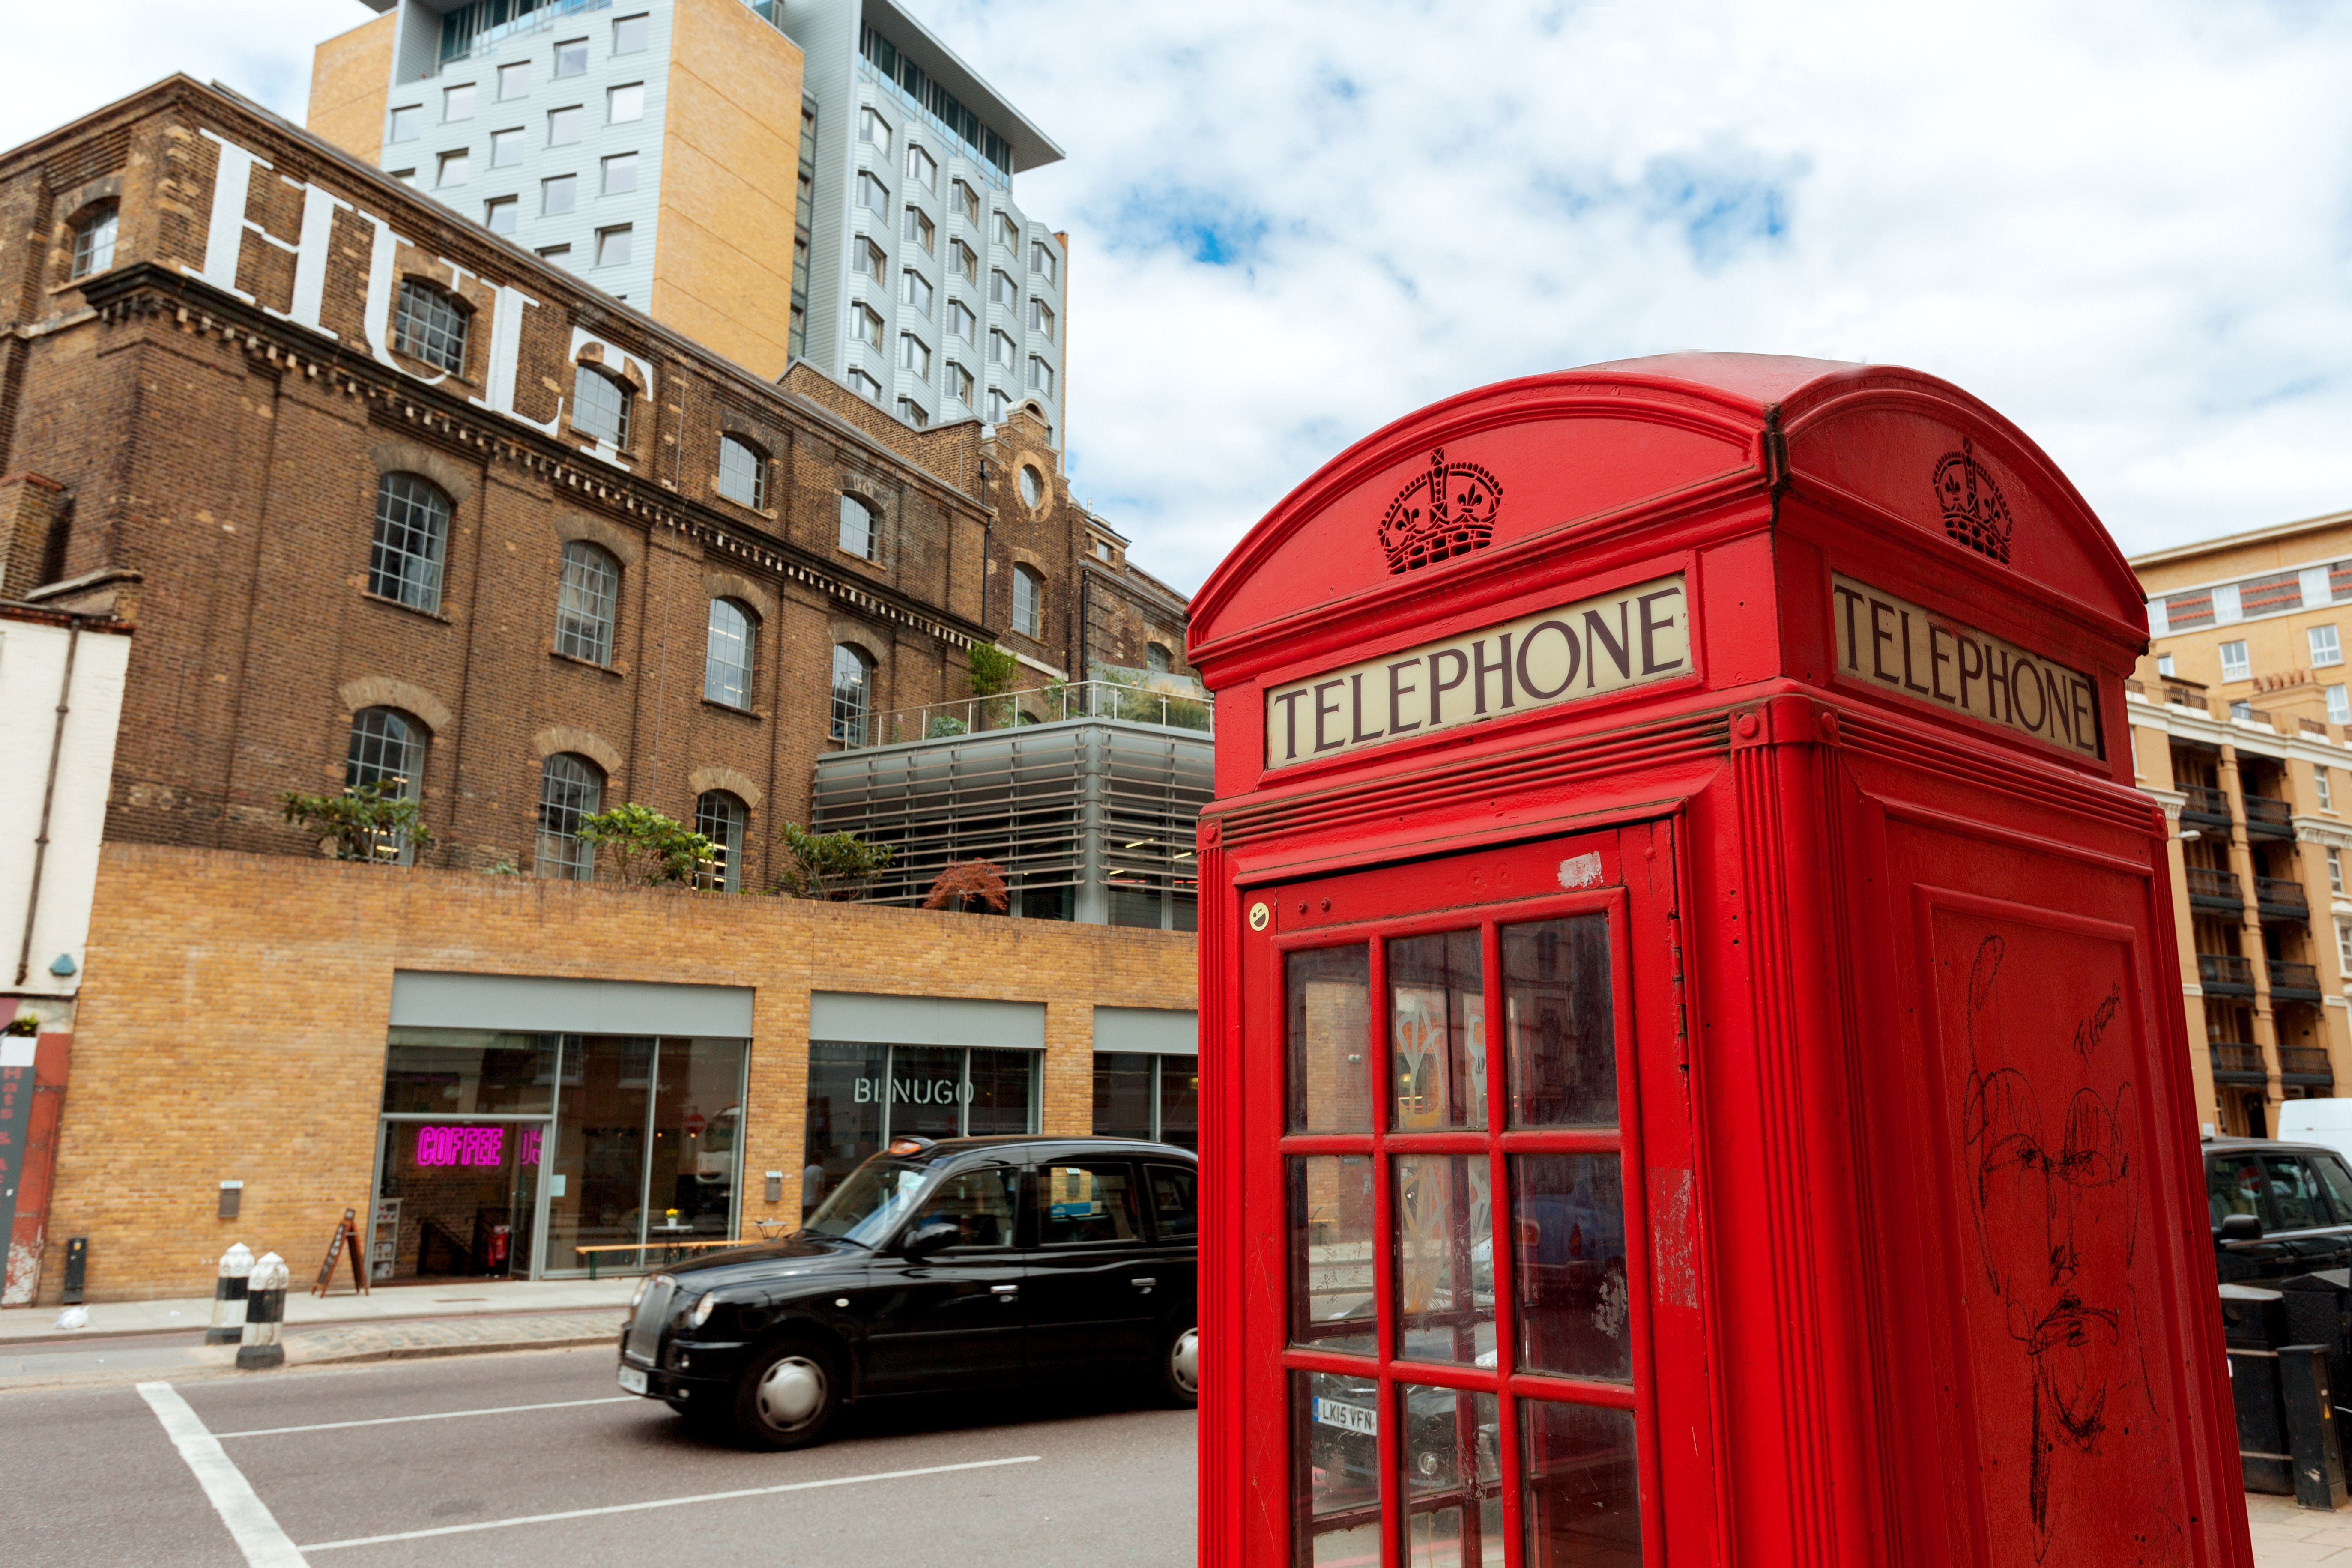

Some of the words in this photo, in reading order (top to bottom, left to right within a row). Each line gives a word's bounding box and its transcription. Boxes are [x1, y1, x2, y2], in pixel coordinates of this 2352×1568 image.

[180, 127, 653, 471] HULT
[1273, 587, 1683, 759] TELEPHONE
[1834, 585, 2094, 751] TELEPHONE
[417, 1126, 503, 1165] COFFEE
[1323, 1402, 1347, 1424] LK15
[1350, 1408, 1372, 1430] VFN
